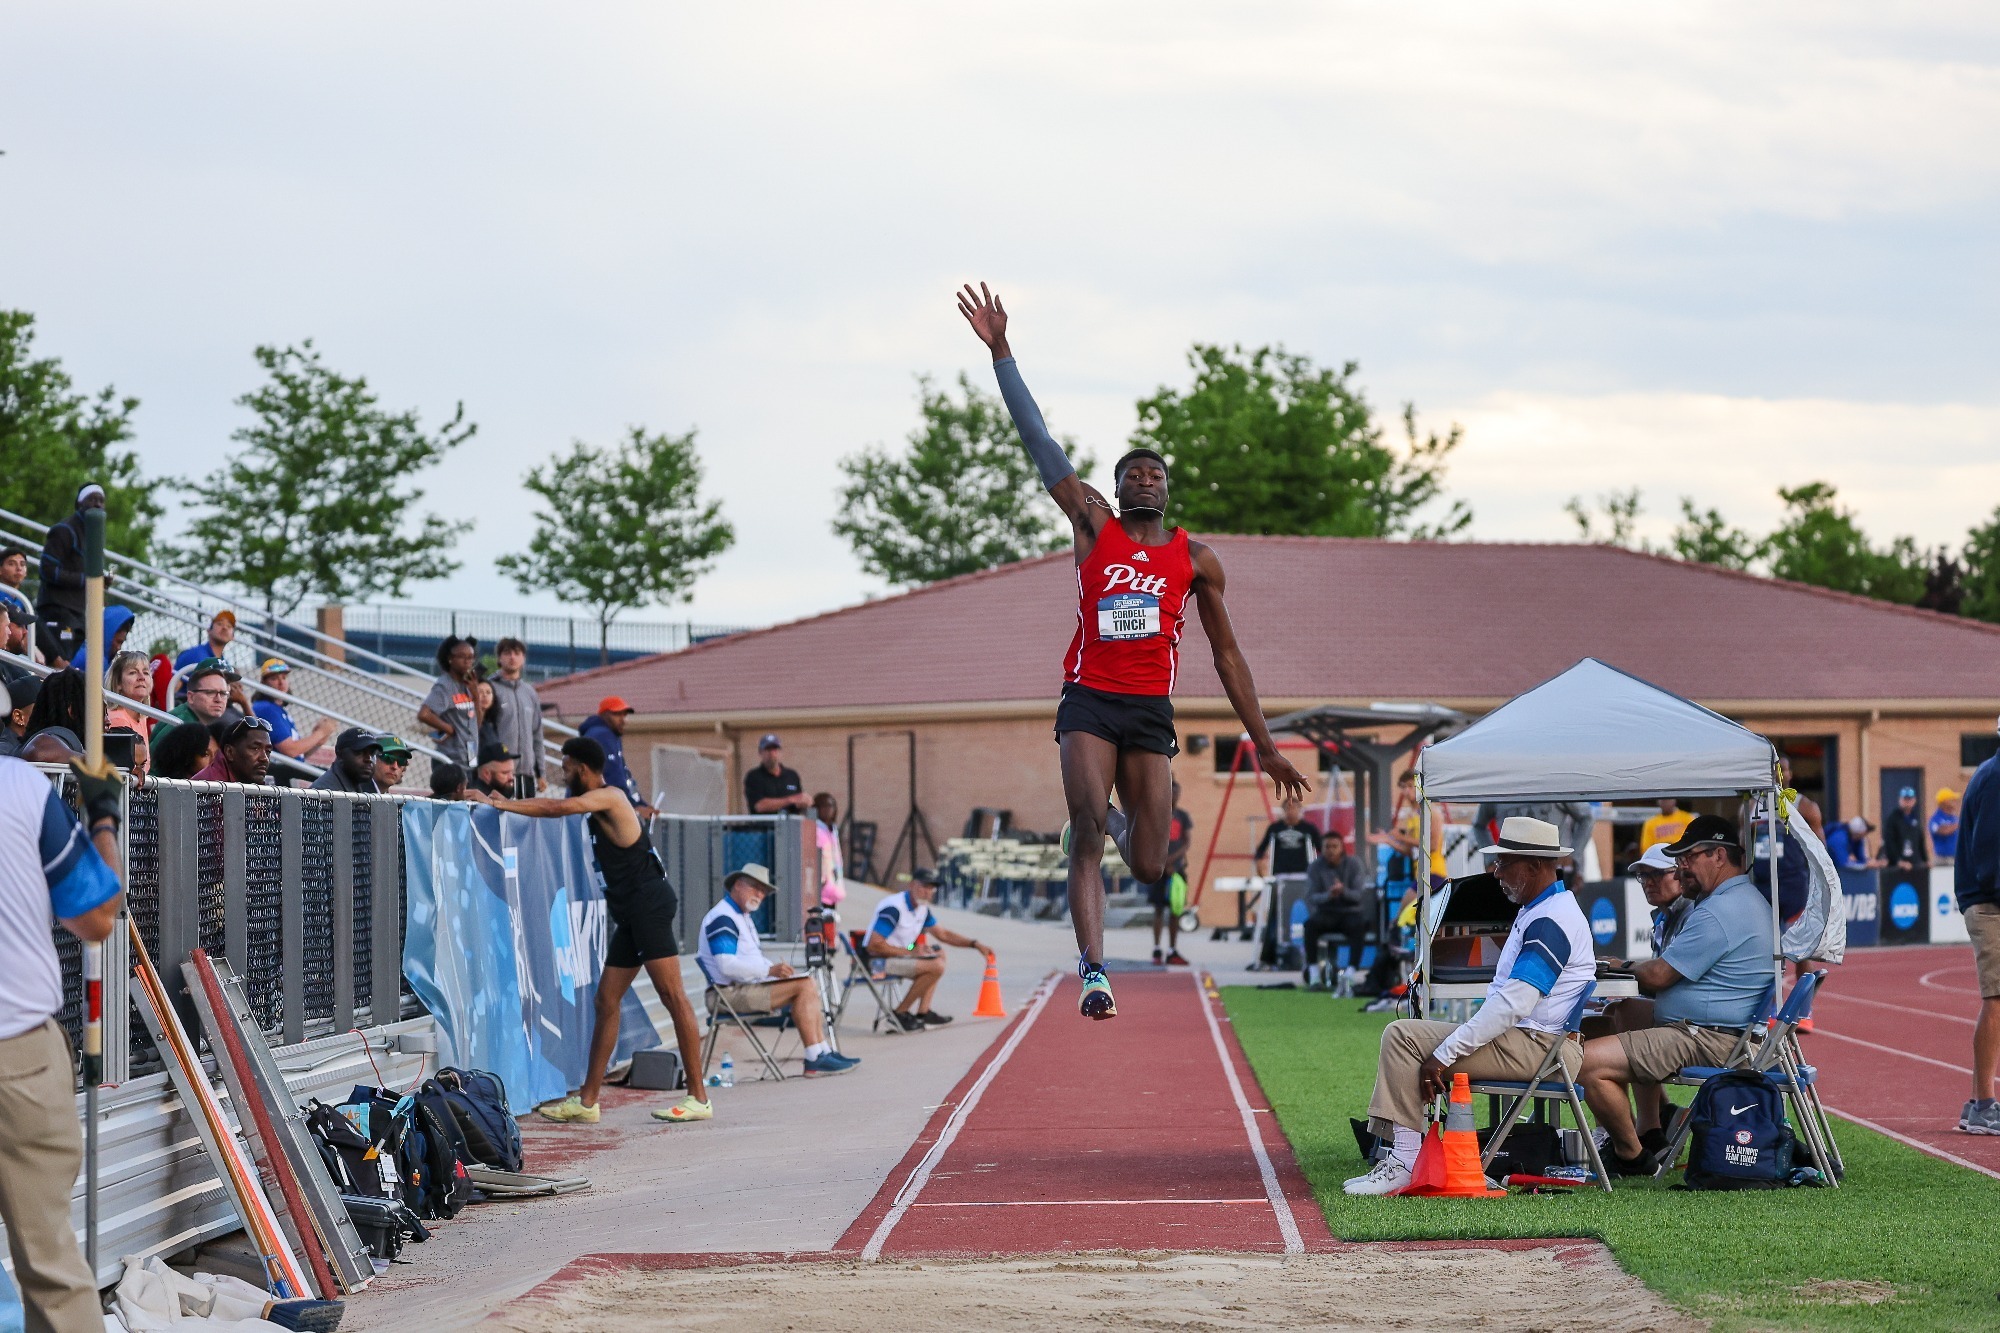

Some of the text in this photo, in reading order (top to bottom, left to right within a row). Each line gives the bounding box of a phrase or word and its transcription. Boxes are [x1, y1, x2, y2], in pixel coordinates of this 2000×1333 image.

[1103, 564, 1167, 596] Pitt
[1112, 609, 1147, 619] CORDELL
[1113, 619, 1146, 631] TINCH
[1726, 1152, 1739, 1161] TEAM
